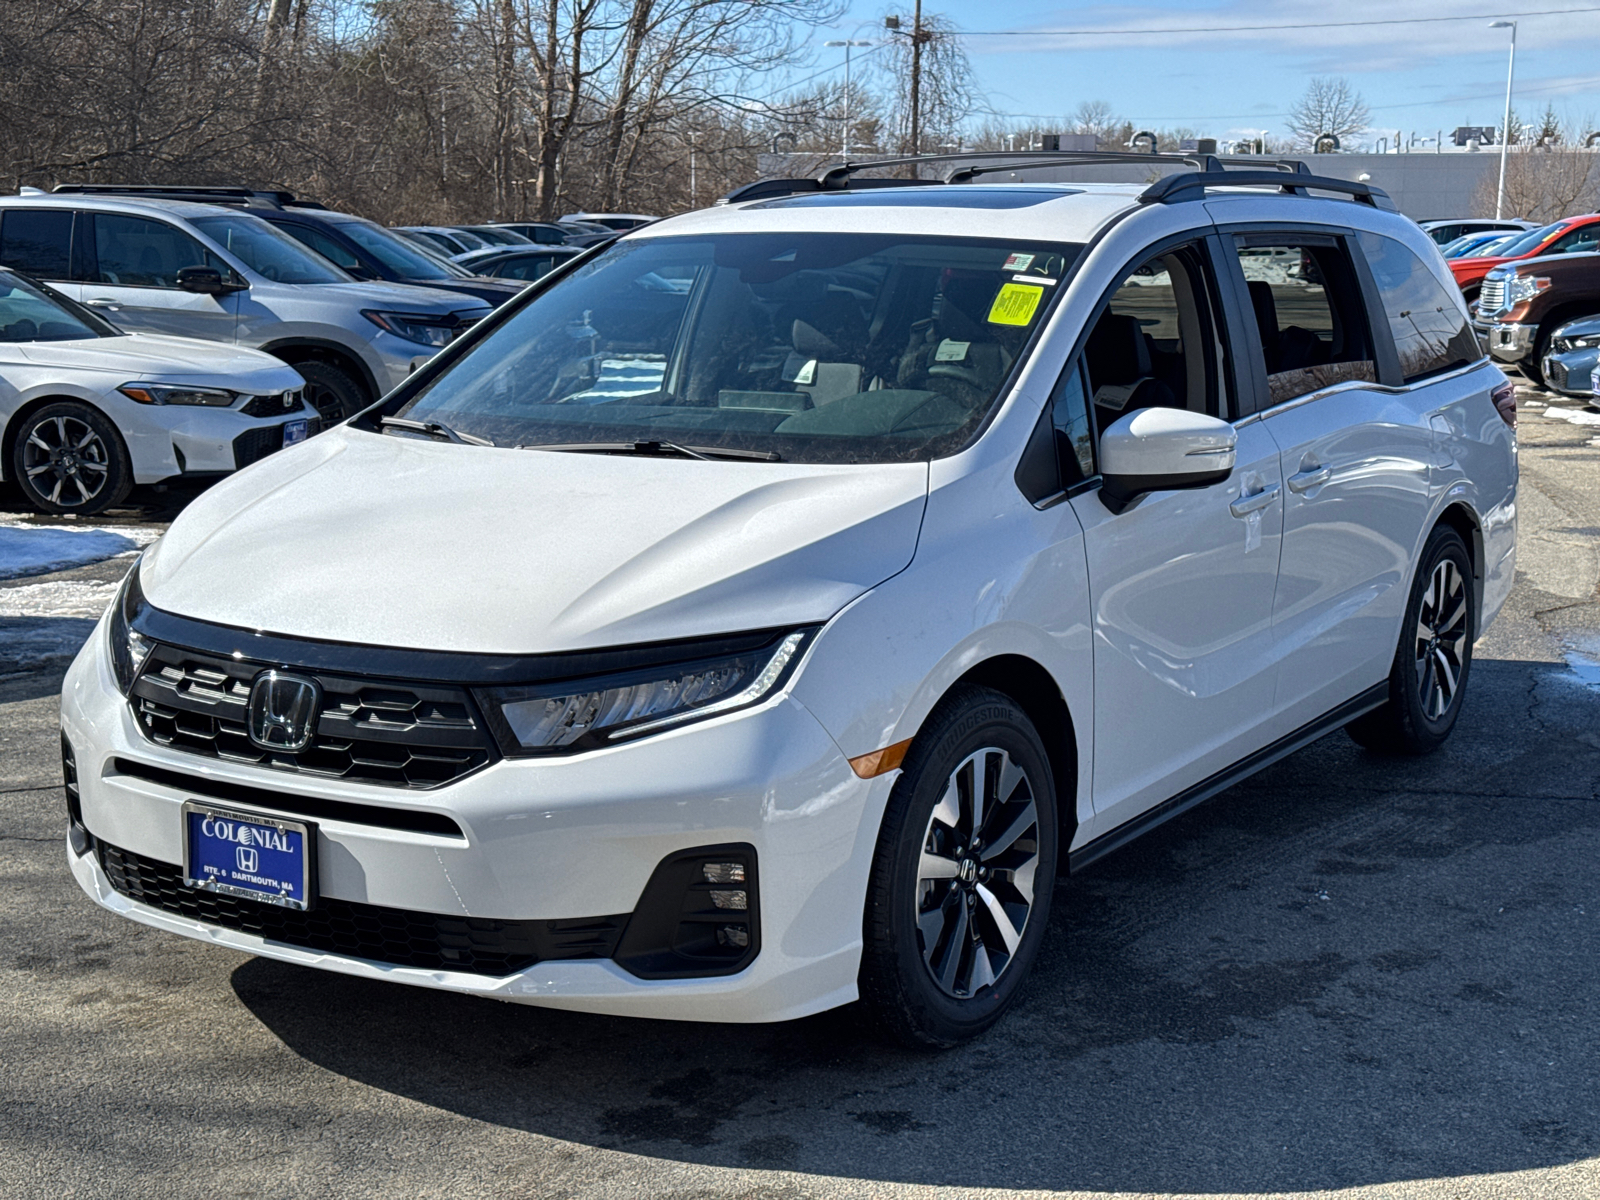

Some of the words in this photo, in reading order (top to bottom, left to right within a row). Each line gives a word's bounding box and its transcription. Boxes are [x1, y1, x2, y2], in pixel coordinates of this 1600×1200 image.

[937, 707, 1013, 760] BRIDGESTONE
[202, 819, 293, 852] COLONIAL
[204, 865, 220, 875] RTE.
[221, 869, 227, 877] 6
[232, 872, 280, 889] DARTMOUTH,
[281, 881, 294, 892] MA
